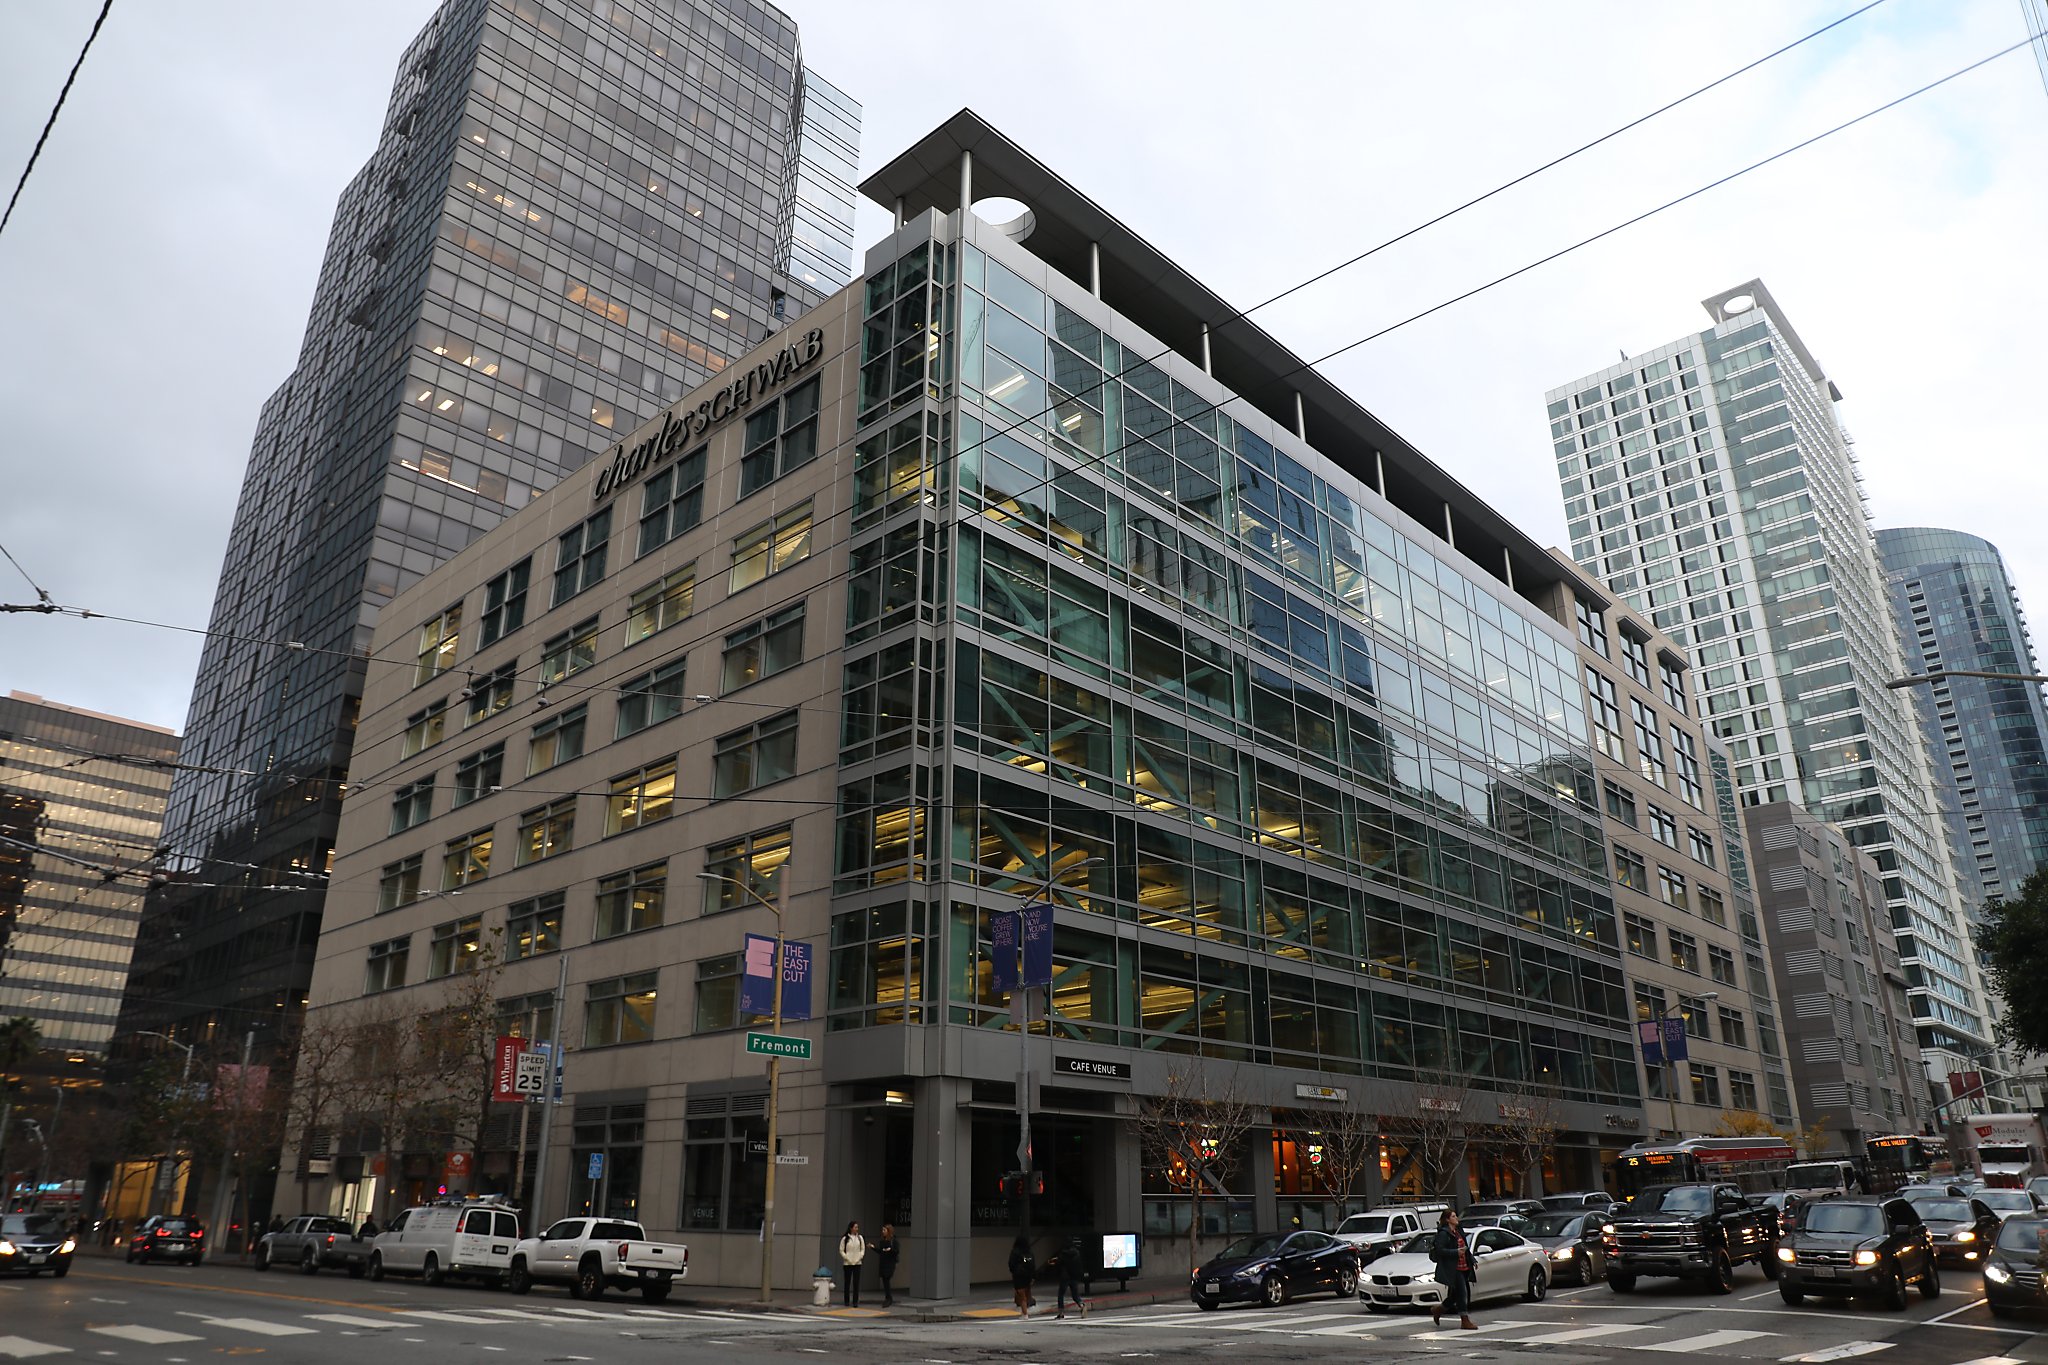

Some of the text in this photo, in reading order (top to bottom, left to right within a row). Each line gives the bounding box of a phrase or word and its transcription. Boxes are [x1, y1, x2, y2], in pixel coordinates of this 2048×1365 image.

[594, 328, 824, 501] charles SCHWAB
[784, 944, 804, 958] THE
[784, 957, 809, 971] EAST
[783, 970, 805, 983] CUT
[1665, 1027, 1684, 1035] EAST
[1666, 1034, 1681, 1042] CUT
[753, 1038, 805, 1054] Fremont
[501, 1045, 512, 1084] Wharton
[520, 1055, 545, 1064] SPEED
[1070, 1061, 1117, 1075] CAFE VENUE
[518, 1074, 542, 1090] 25
[1628, 1157, 1639, 1166] 25
[692, 1207, 715, 1218] VENUE
[977, 1207, 1008, 1218] VENUE
